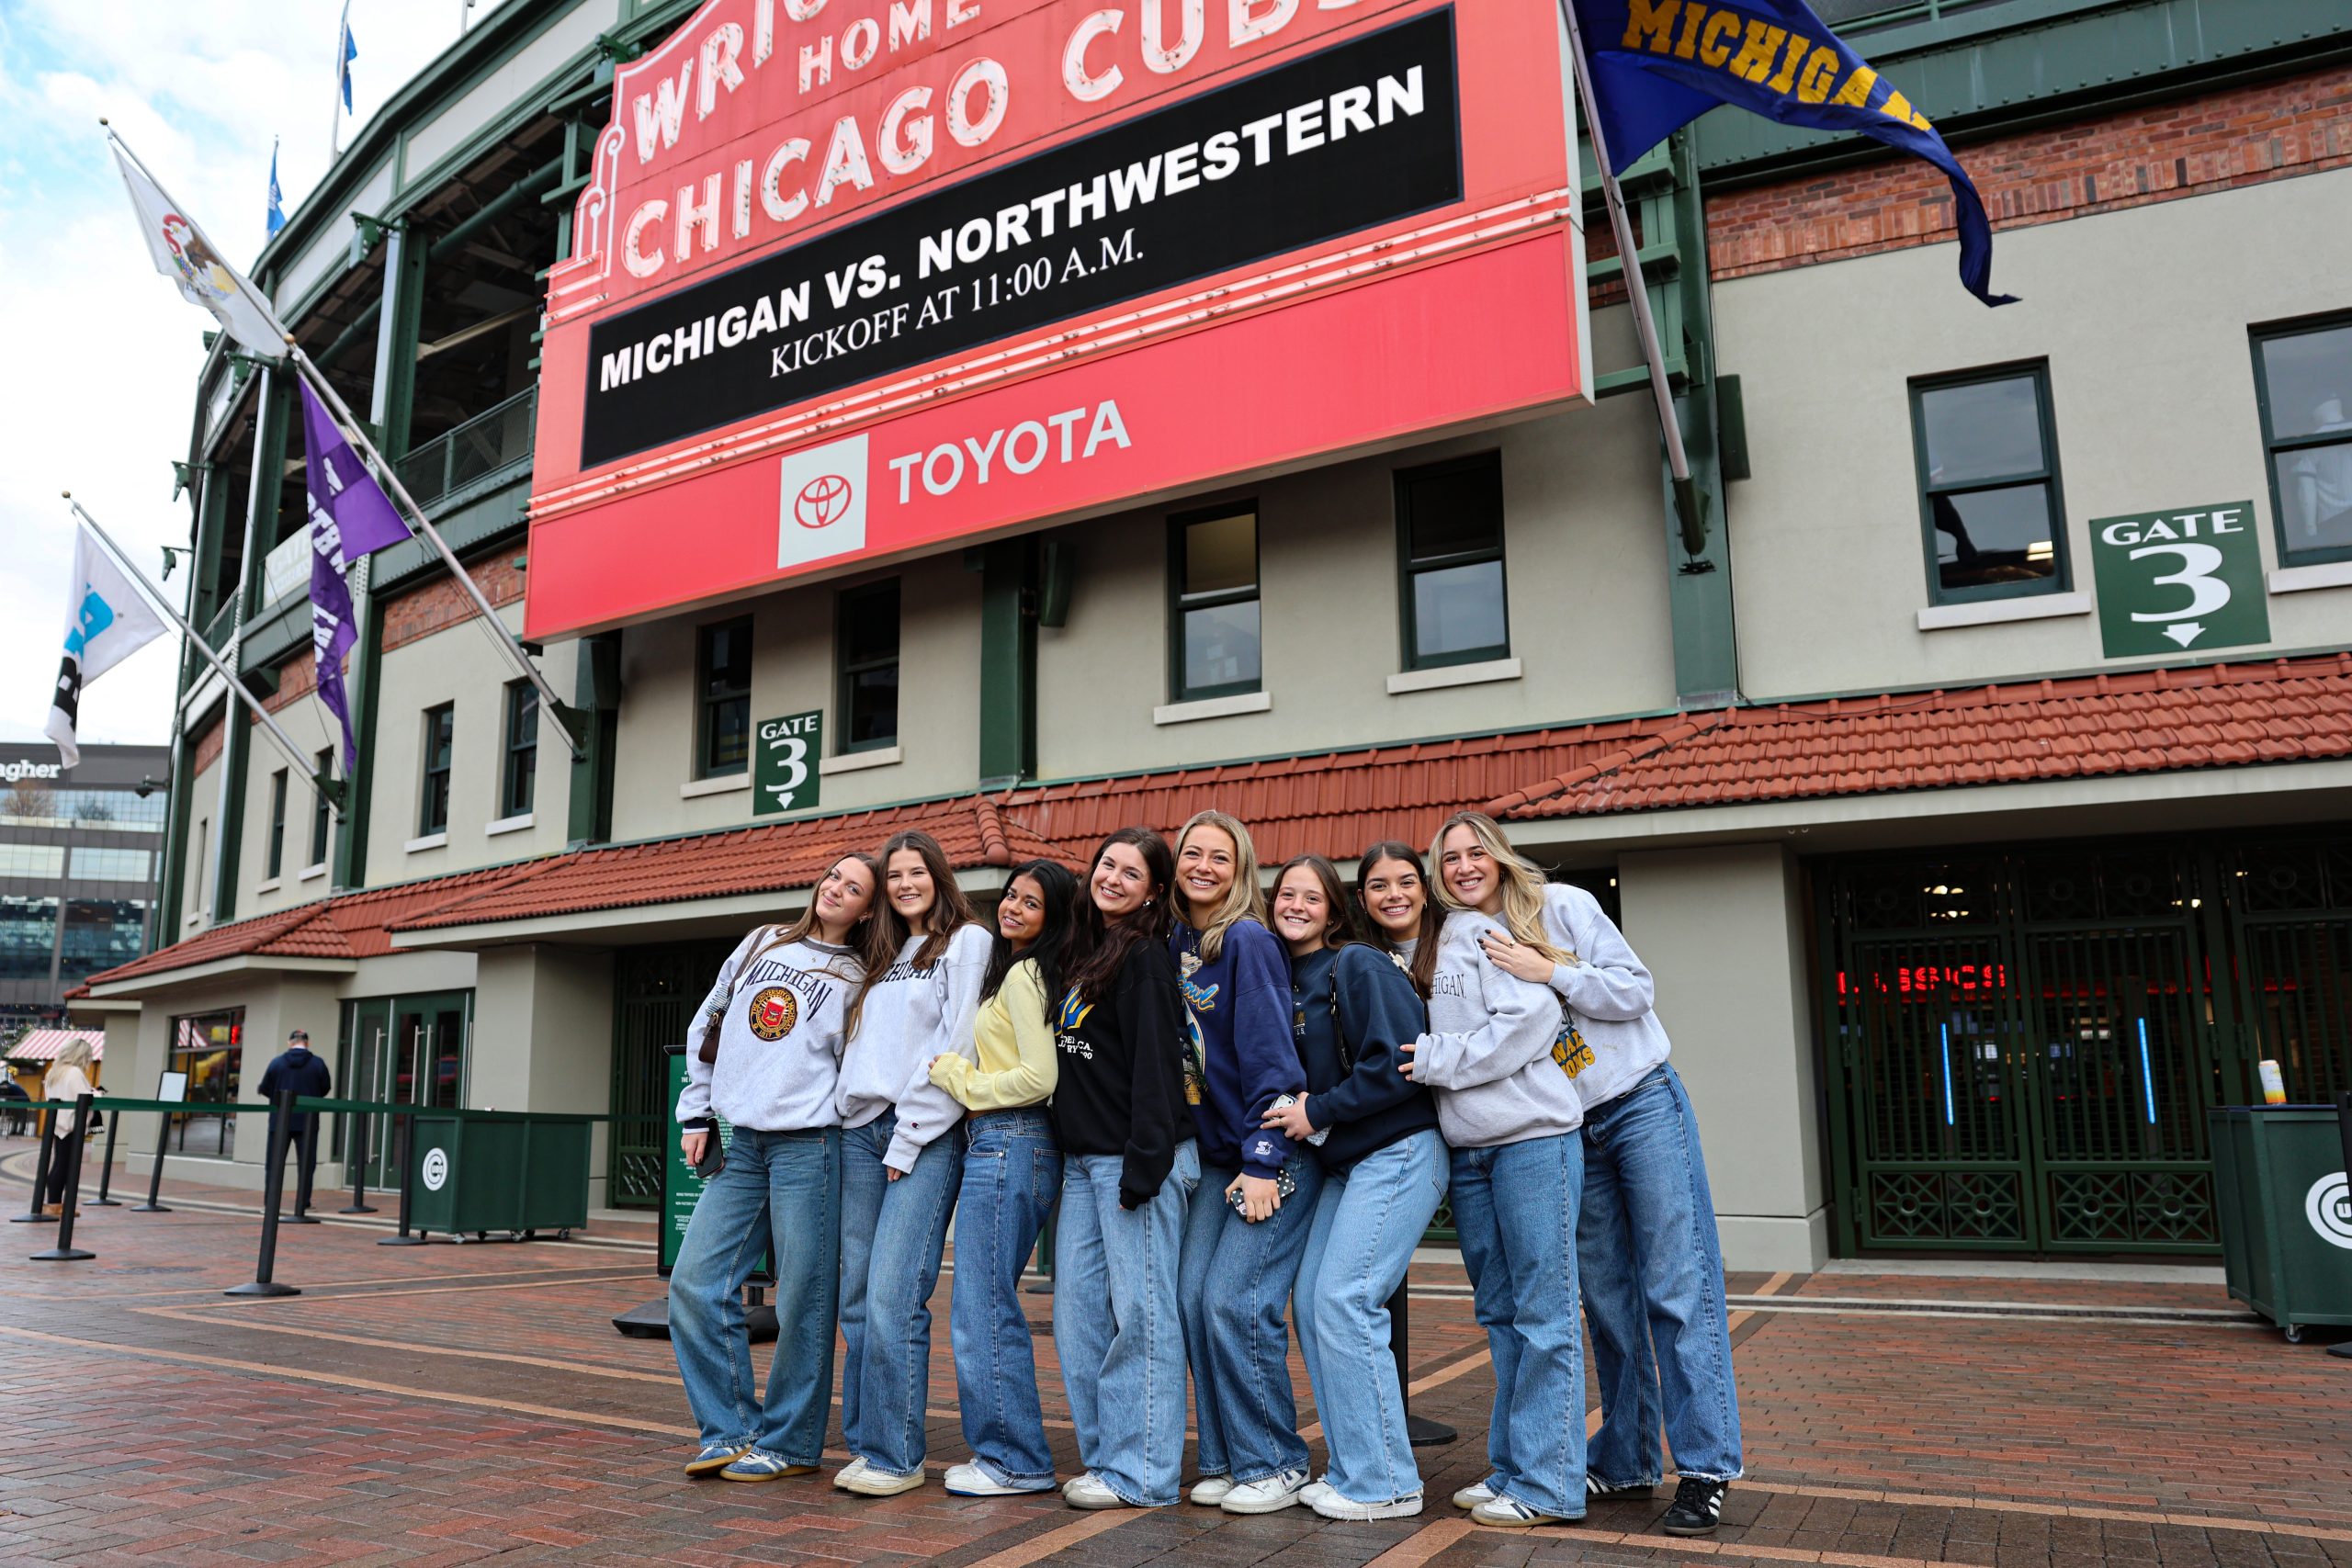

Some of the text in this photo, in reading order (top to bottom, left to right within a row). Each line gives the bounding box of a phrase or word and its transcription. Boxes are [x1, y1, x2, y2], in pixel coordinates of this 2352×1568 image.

[632, 0, 829, 165] WRI
[620, 0, 1369, 277] CHICAGO CUB
[599, 64, 1425, 392] MICHIGAN VS. NORTHWESTERN
[769, 228, 1144, 378] KICKOFF AT 11:00 A.M.
[888, 399, 1133, 504] TOYOTA
[2101, 509, 2244, 546] GATE
[2129, 542, 2232, 623] 3
[760, 715, 818, 740] GATE
[765, 738, 808, 793] 3
[736, 958, 833, 1022] MICHIGAN
